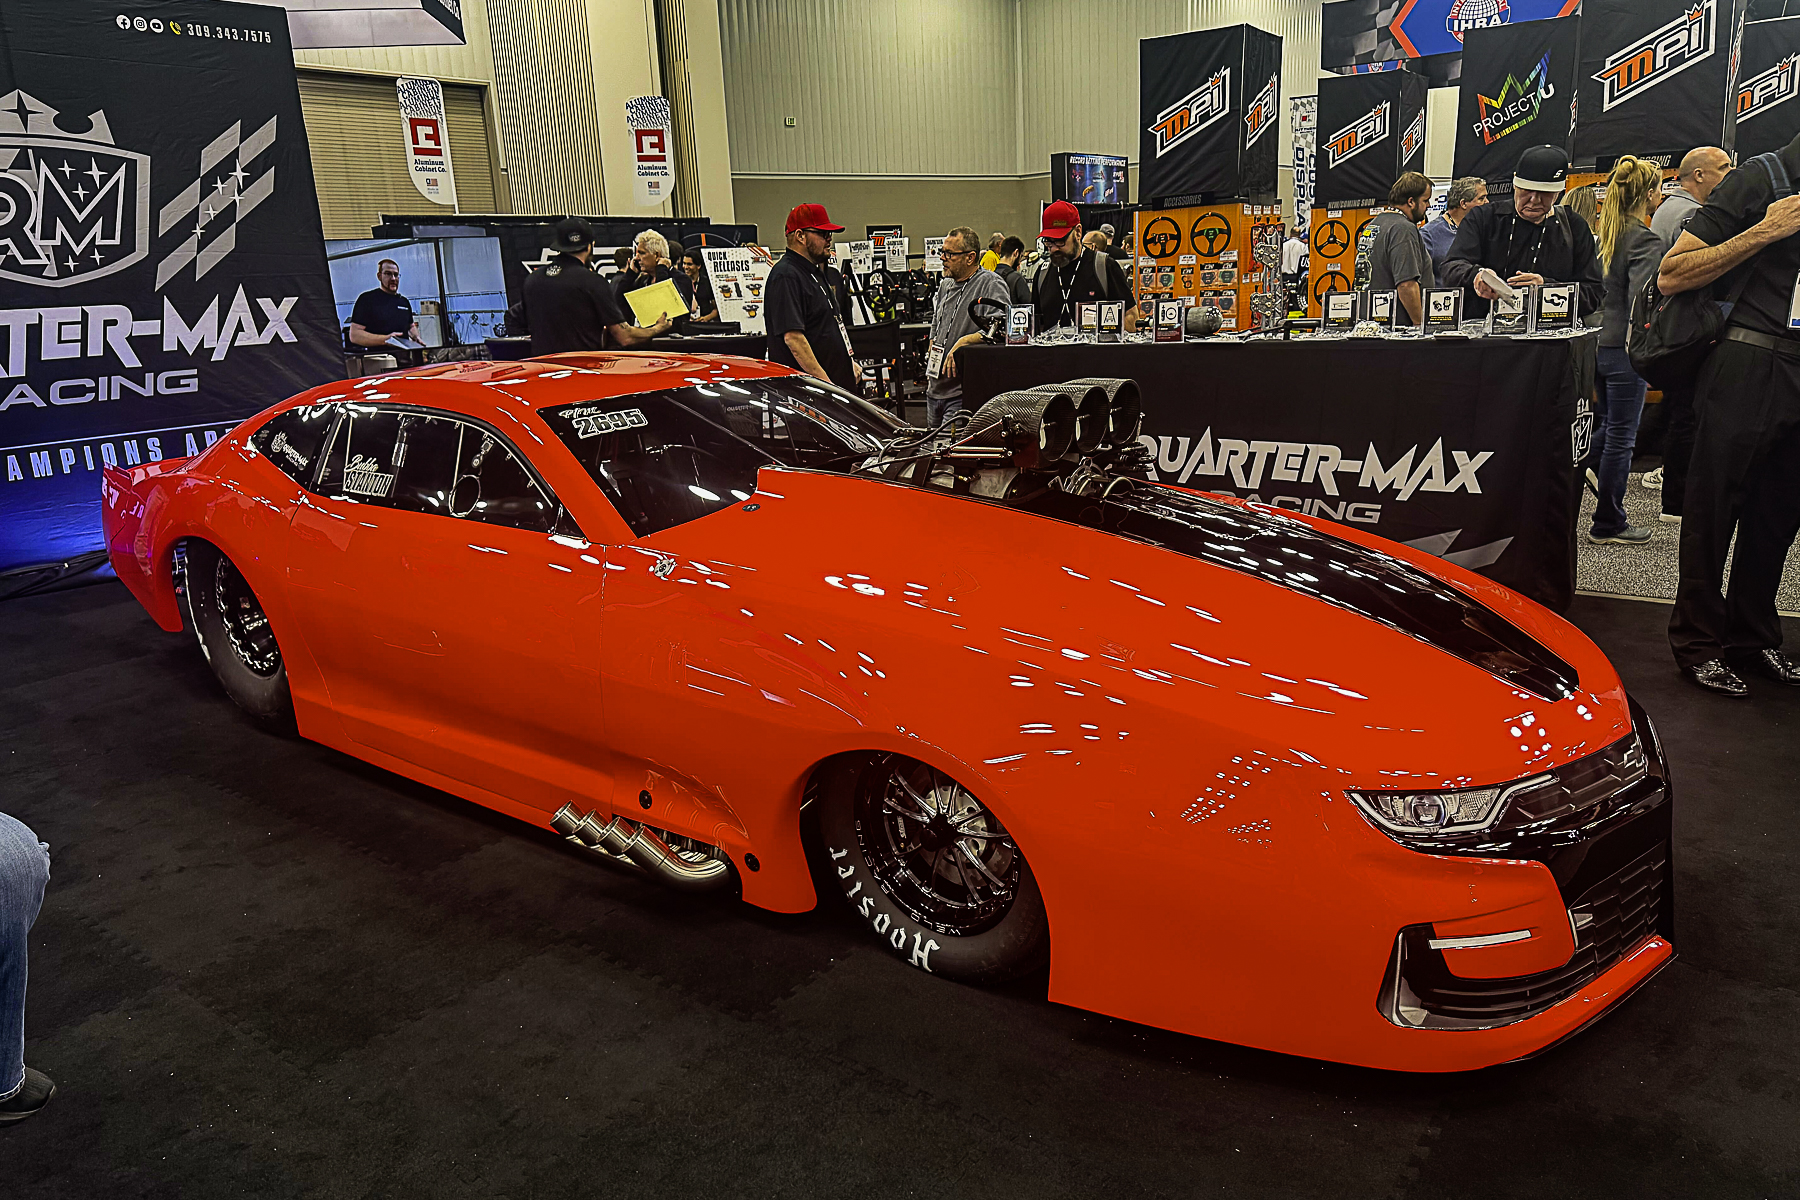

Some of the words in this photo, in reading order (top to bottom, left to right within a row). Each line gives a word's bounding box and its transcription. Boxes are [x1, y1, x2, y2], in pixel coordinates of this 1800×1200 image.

[187, 23, 272, 44] 309.343.7575
[1453, 14, 1502, 32] IHRA
[1473, 94, 1543, 138] PROJECT
[1164, 193, 1202, 208] ACCESSORIES
[707, 251, 728, 262] QUICK
[713, 260, 750, 272] RELEASES
[572, 408, 649, 440] 2695
[7, 437, 163, 482] AMPIONS
[344, 454, 379, 473] Bubba
[1136, 425, 1494, 501] QUARTER-MAX
[344, 470, 394, 497] STANTON
